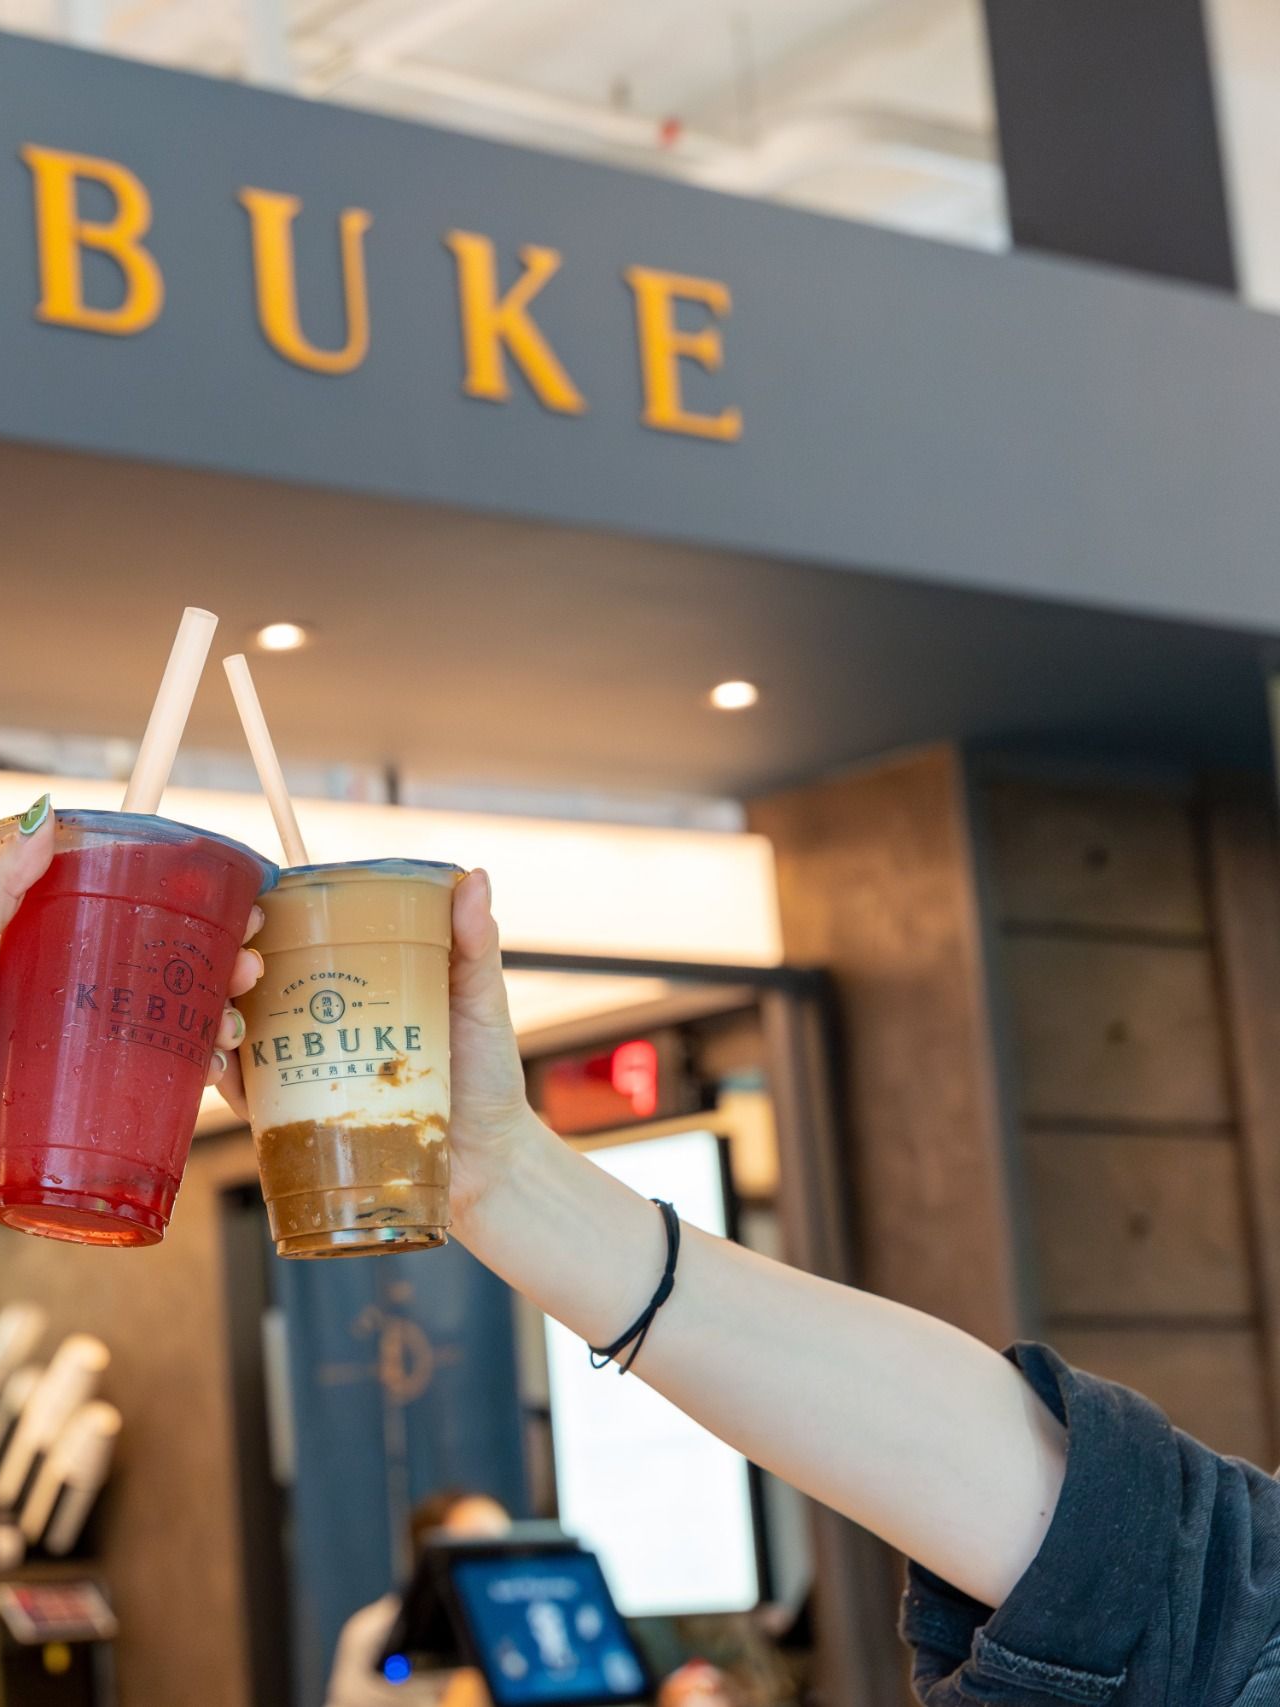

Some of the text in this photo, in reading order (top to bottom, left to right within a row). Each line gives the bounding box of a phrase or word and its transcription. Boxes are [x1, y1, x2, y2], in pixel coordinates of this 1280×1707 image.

[283, 971, 369, 995] TEA COMPANY
[76, 983, 215, 1045] KEBUK
[251, 1025, 422, 1068] KEBUKE
